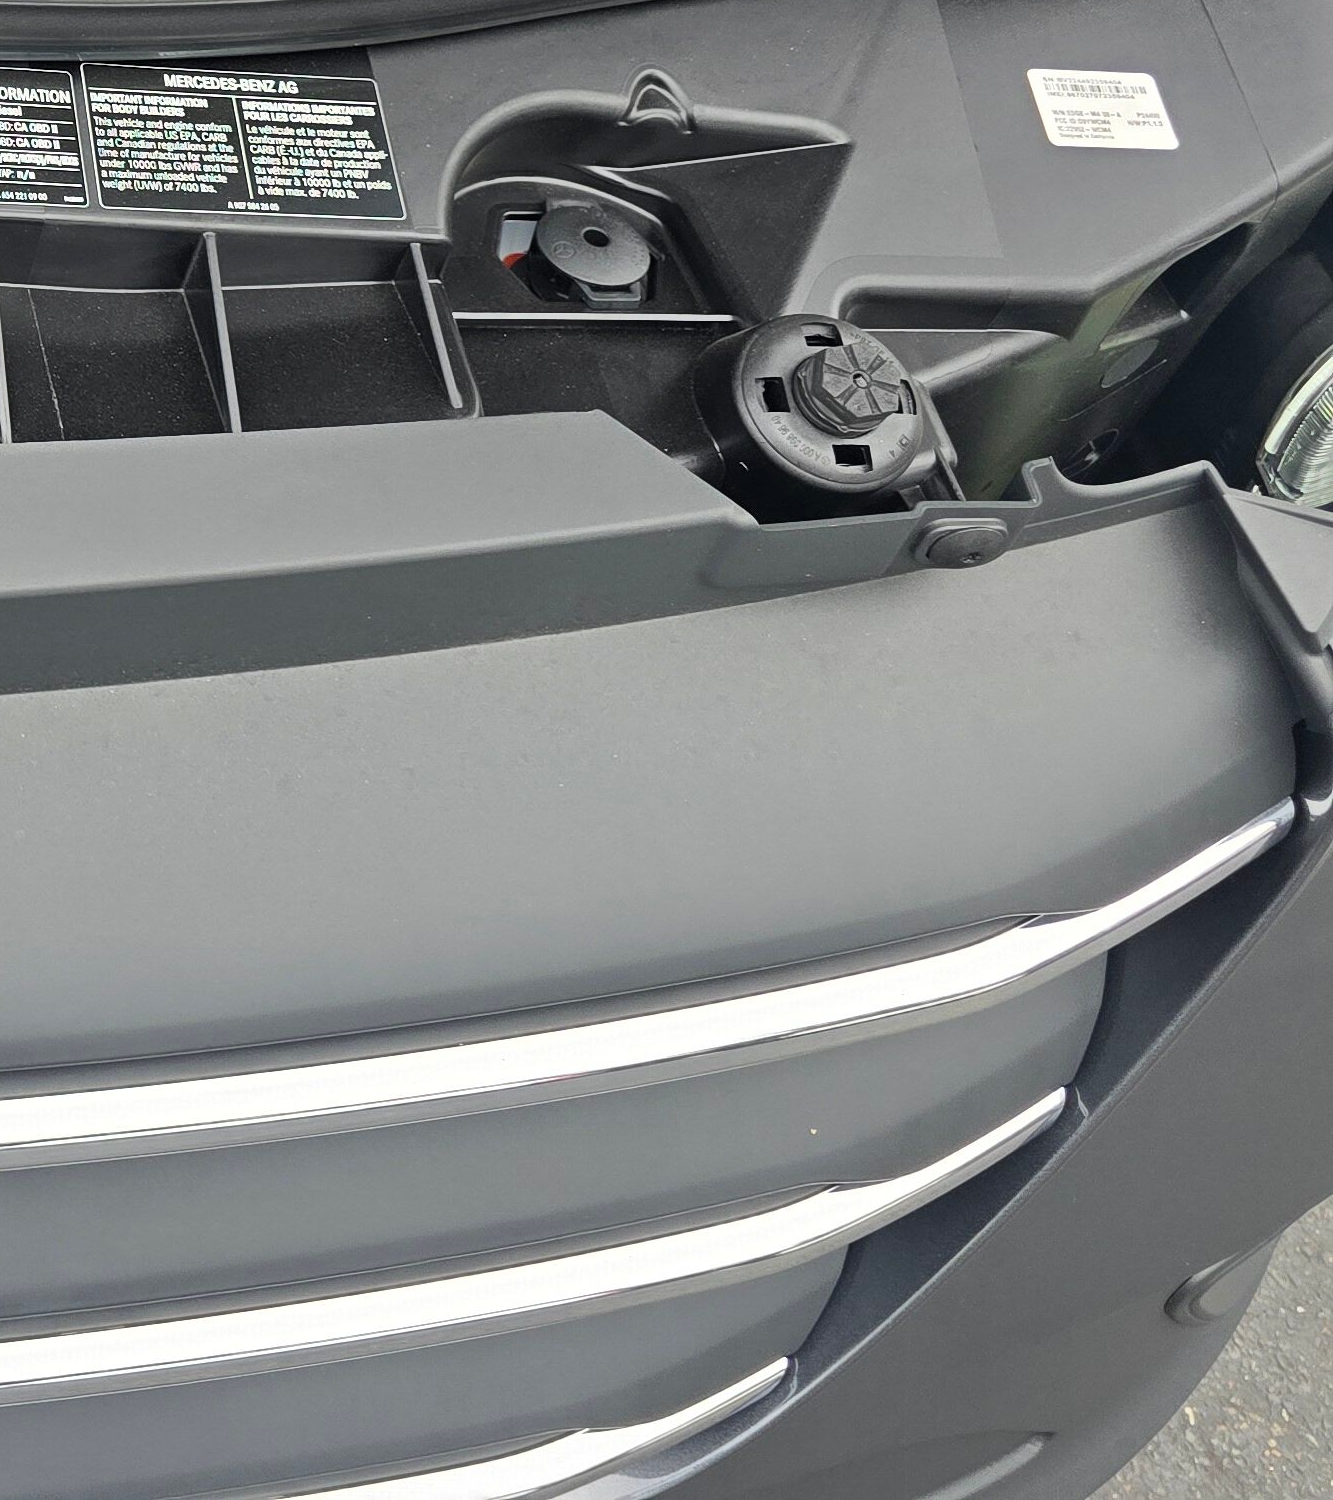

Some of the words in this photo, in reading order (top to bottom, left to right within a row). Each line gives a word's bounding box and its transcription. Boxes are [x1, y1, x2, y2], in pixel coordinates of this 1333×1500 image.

[164, 74, 276, 93] MERCEDES-BENZ
[278, 81, 299, 94] AG
[90, 92, 143, 105] IMPORTANT
[144, 95, 208, 108] INFORMATION
[91, 104, 112, 113] FOR
[113, 104, 139, 115] BODY
[140, 106, 185, 117] BUILDERS
[243, 111, 271, 121] POUR
[271, 112, 289, 122] LES
[29, 123, 50, 134] OBD
[93, 116, 113, 126] This
[113, 118, 144, 128] vehicle
[146, 119, 163, 129] and
[164, 121, 194, 132] engine
[195, 122, 233, 133] conform
[95, 127, 105, 136] to
[107, 128, 118, 137] all
[119, 129, 163, 140] applicable
[164, 130, 178, 140] US
[179, 131, 201, 143] EPA,
[202, 132, 228, 143] CARB
[246, 124, 258, 134] Le
[296, 127, 306, 137] et
[307, 128, 316, 137] le
[317, 129, 349, 138] moteur
[349, 130, 370, 139] sont
[31, 138, 52, 149] OBD
[97, 138, 114, 147] and
[115, 138, 156, 149] Canadian
[158, 140, 207, 152] regulations
[208, 142, 218, 152] at
[218, 143, 234, 153] the
[248, 135, 295, 145] conformes
[296, 138, 312, 146] aux
[313, 138, 355, 148] directives
[98, 148, 119, 157] time
[120, 148, 130, 158] of
[131, 149, 187, 161] manufacture
[188, 151, 200, 161] for
[202, 152, 239, 163] vehicles
[250, 145, 276, 155] CARB
[305, 147, 315, 157] et
[316, 148, 328, 157] du
[329, 148, 363, 159] Canada
[99, 158, 125, 168] under
[128, 159, 157, 170] 10000
[158, 161, 172, 171] lbs
[173, 161, 202, 172] GVWR
[203, 163, 220, 173] and
[221, 163, 238, 174] has
[289, 157, 299, 166] la
[320, 158, 333, 168] de
[333, 159, 382, 169] production
[109, 170, 153, 179] maximum
[154, 172, 195, 182] unloaded
[196, 173, 228, 183] vehicle
[254, 165, 266, 175] du
[305, 168, 330, 178] ayant
[331, 170, 342, 178] un
[102, 179, 133, 191] weight
[134, 180, 163, 192] (UVW)
[164, 181, 174, 191] of
[175, 182, 199, 193] 7400
[200, 183, 218, 193] lbs.
[302, 177, 332, 188] 10000
[343, 179, 353, 189] et
[353, 181, 366, 189] un
[265, 186, 284, 196] vide
[308, 188, 321, 198] de
[322, 188, 346, 199] 7400
